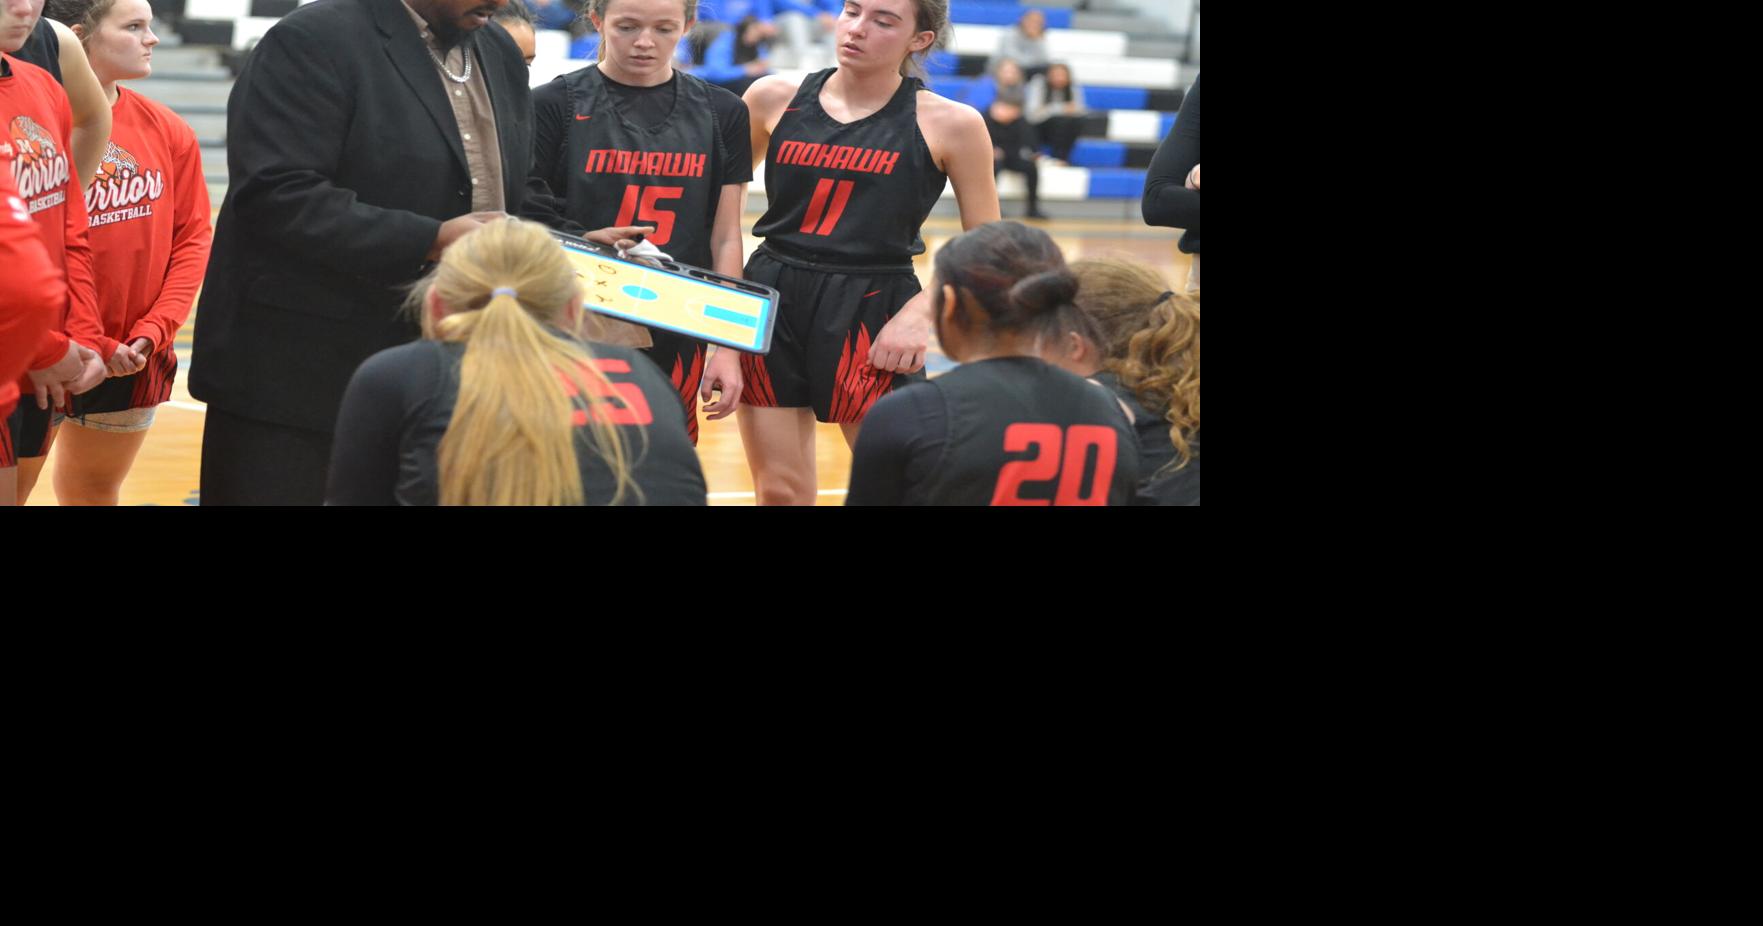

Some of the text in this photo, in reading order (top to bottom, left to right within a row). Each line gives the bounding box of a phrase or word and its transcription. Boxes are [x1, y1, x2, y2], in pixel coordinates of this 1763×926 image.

[585, 149, 706, 178] MOHAWK
[775, 140, 900, 175] MOHAWK
[85, 169, 164, 213] rriors
[613, 184, 684, 246] 15
[799, 177, 856, 236] 11
[989, 422, 1119, 507] 20
